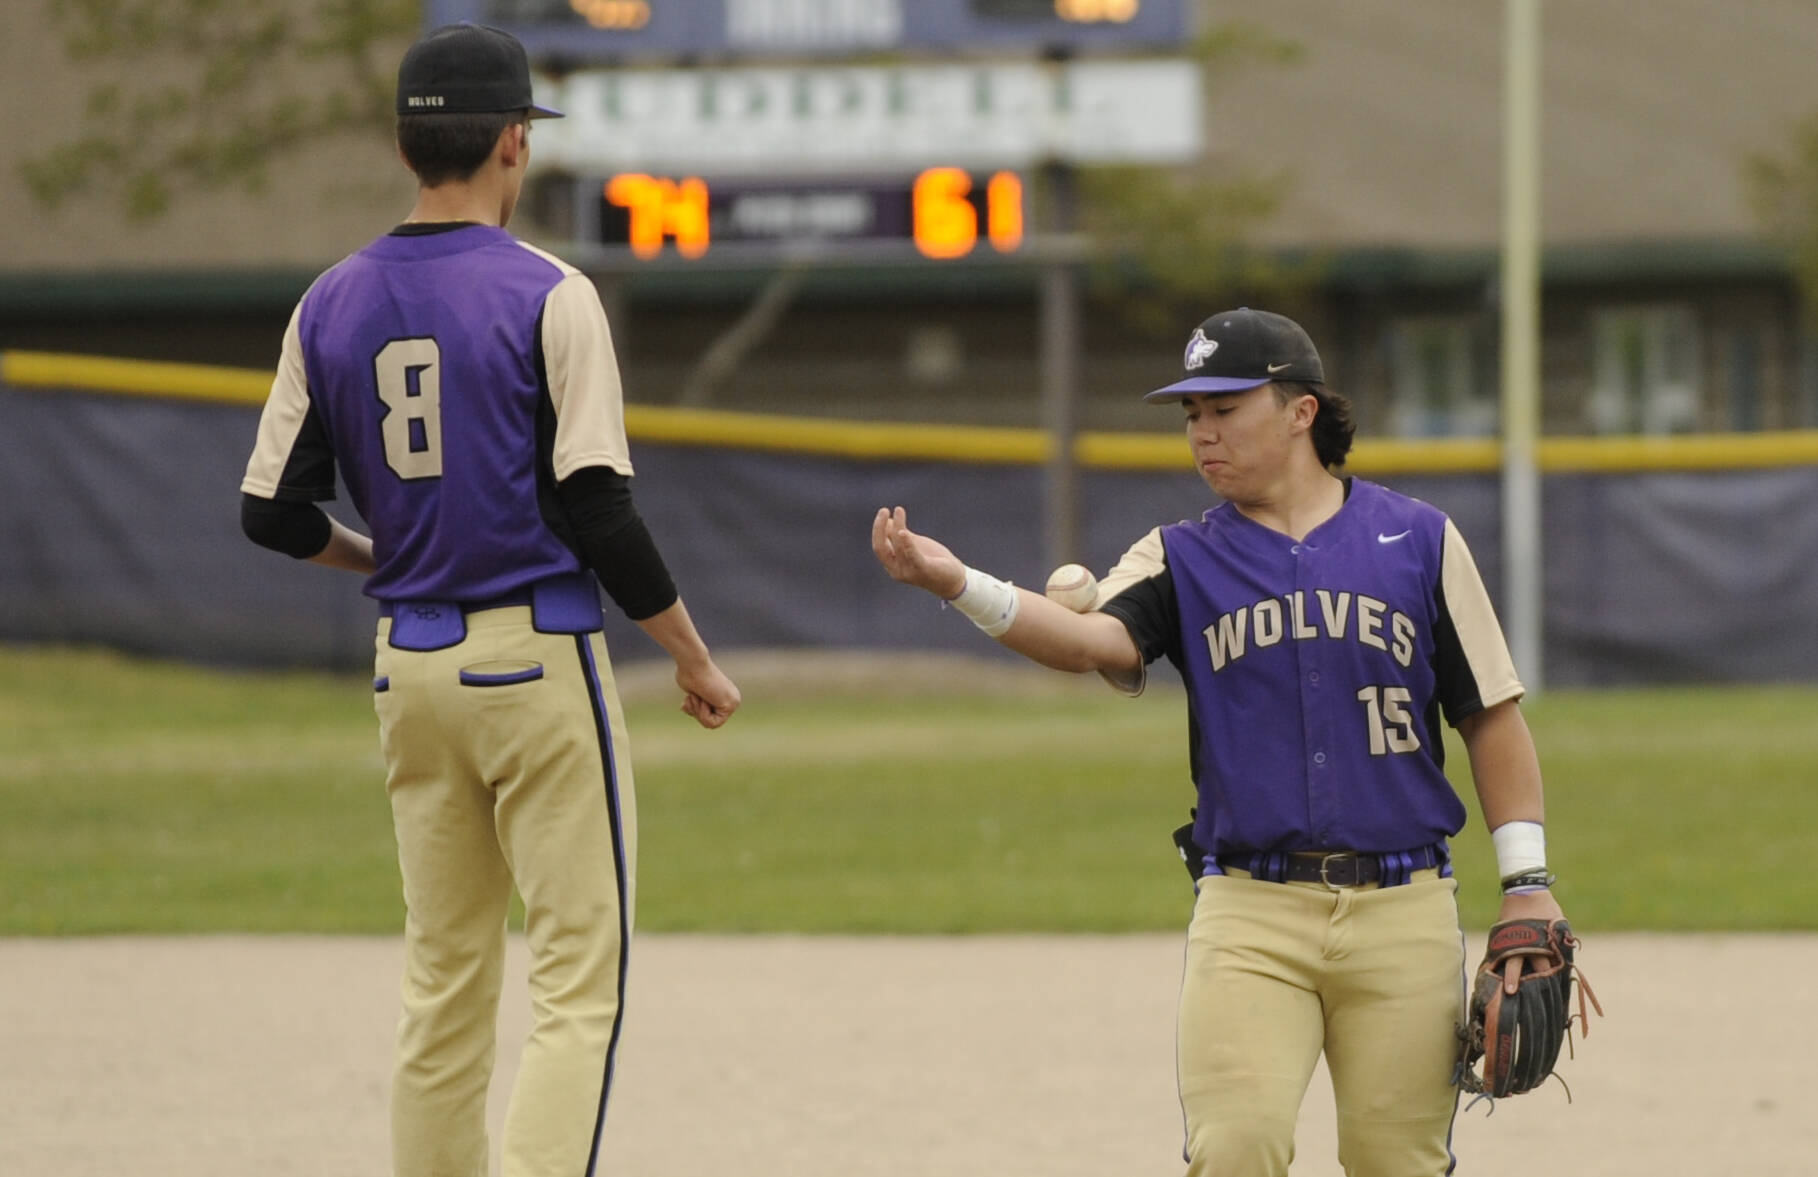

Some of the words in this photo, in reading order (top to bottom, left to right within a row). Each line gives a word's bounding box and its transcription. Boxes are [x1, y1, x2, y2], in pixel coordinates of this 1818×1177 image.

[407, 96, 444, 107] WOLVES
[605, 172, 710, 260] 74
[911, 166, 1024, 260] 61
[372, 336, 443, 481] 8
[1202, 588, 1417, 674] WOLVES
[1355, 684, 1422, 756] 15
